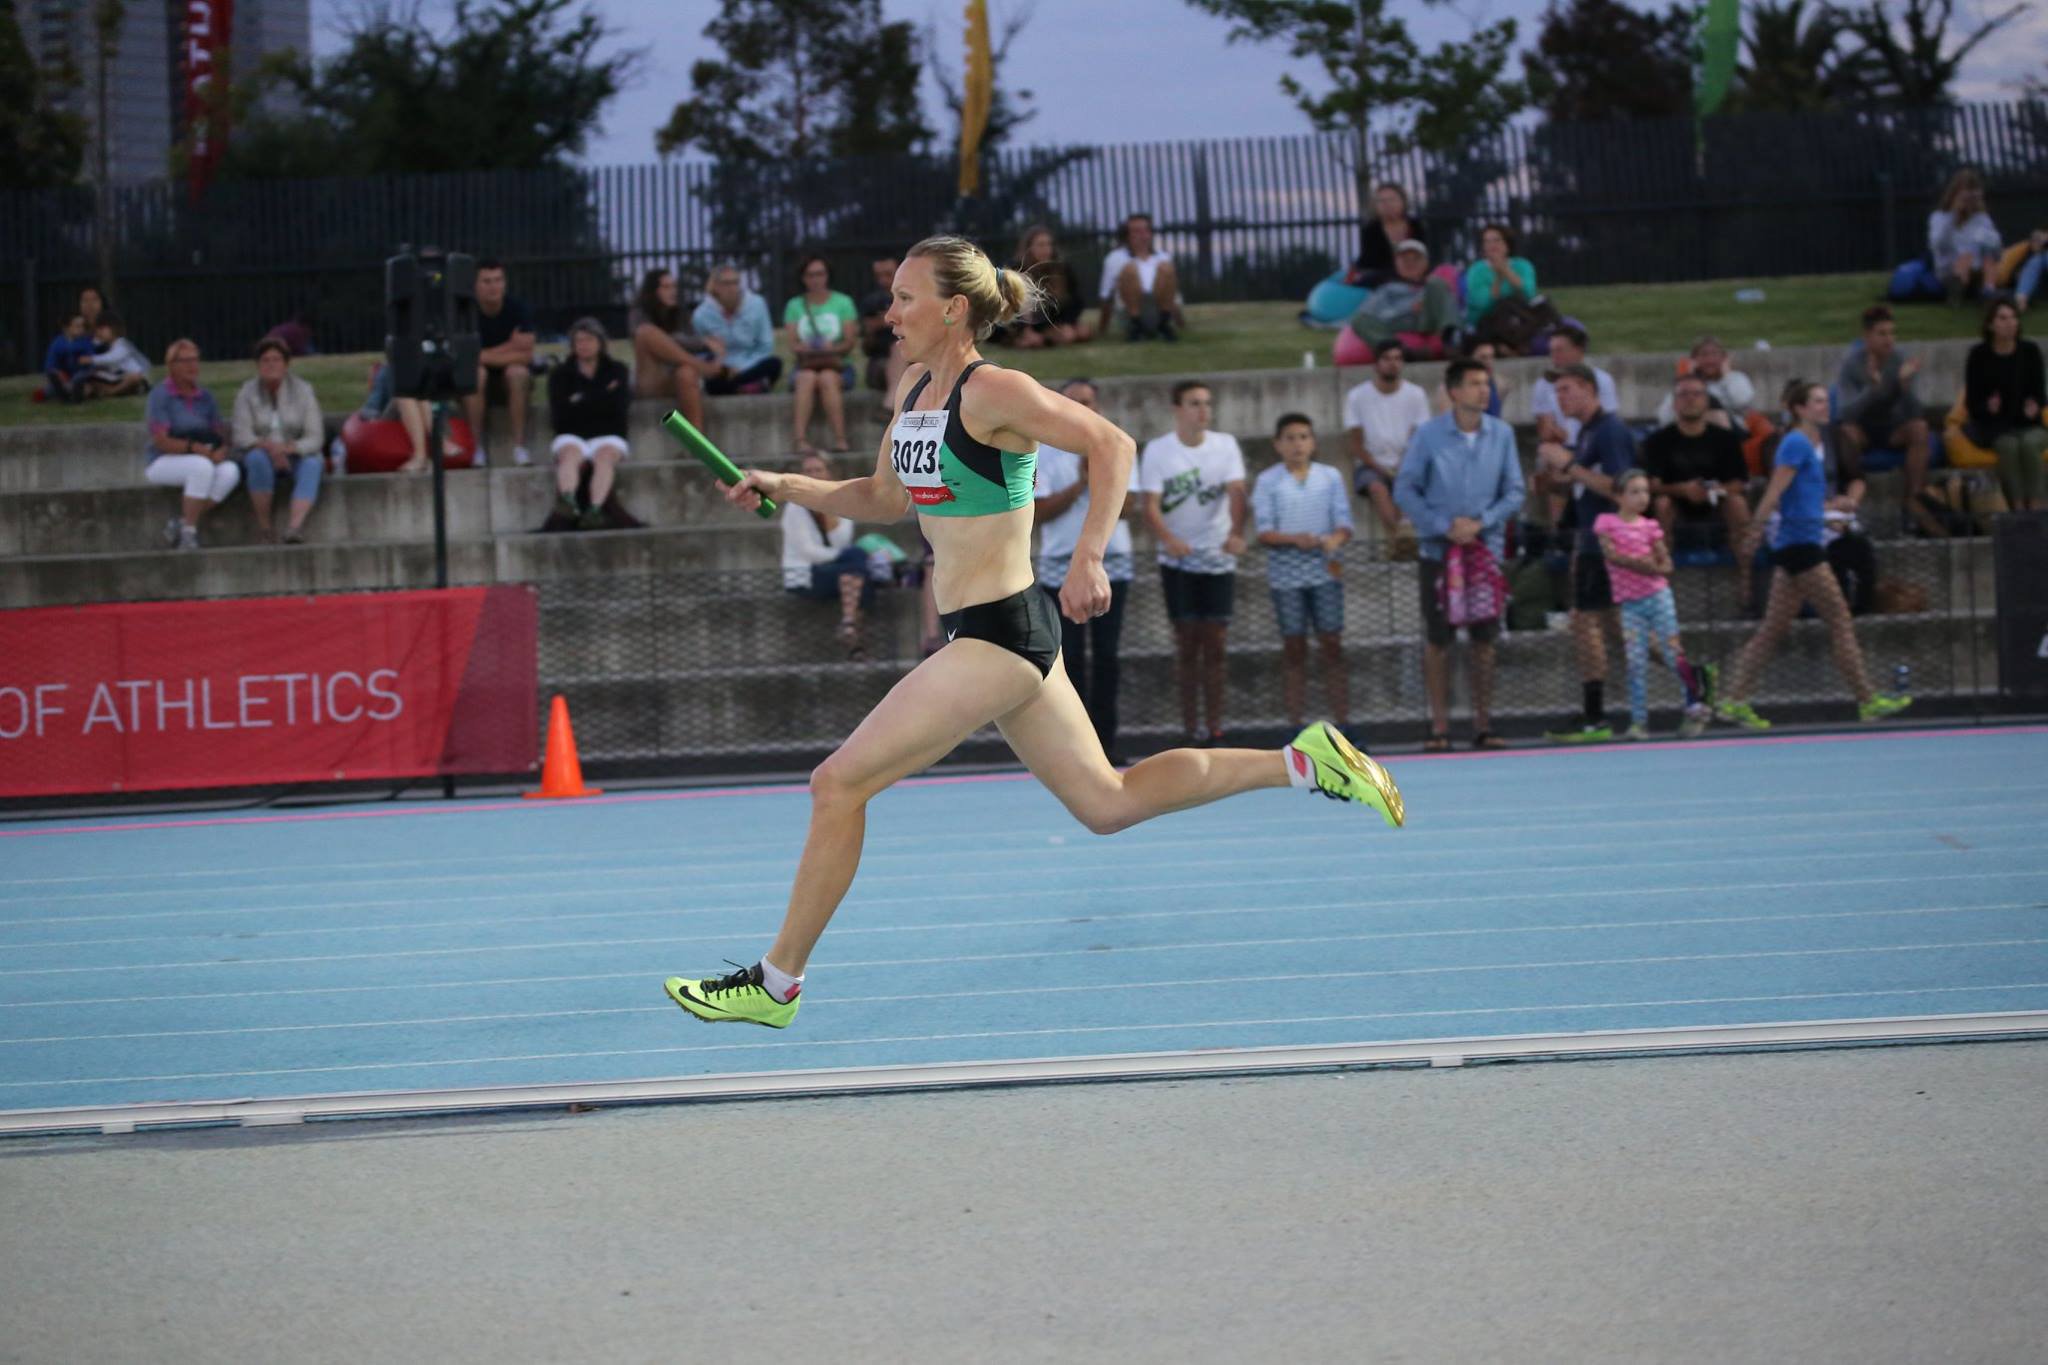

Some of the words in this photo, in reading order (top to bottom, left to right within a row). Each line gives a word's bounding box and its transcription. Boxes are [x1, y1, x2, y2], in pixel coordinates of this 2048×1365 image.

[893, 440, 937, 474] 3023
[0, 683, 69, 739] OF
[82, 669, 403, 735] ATHLETICS
